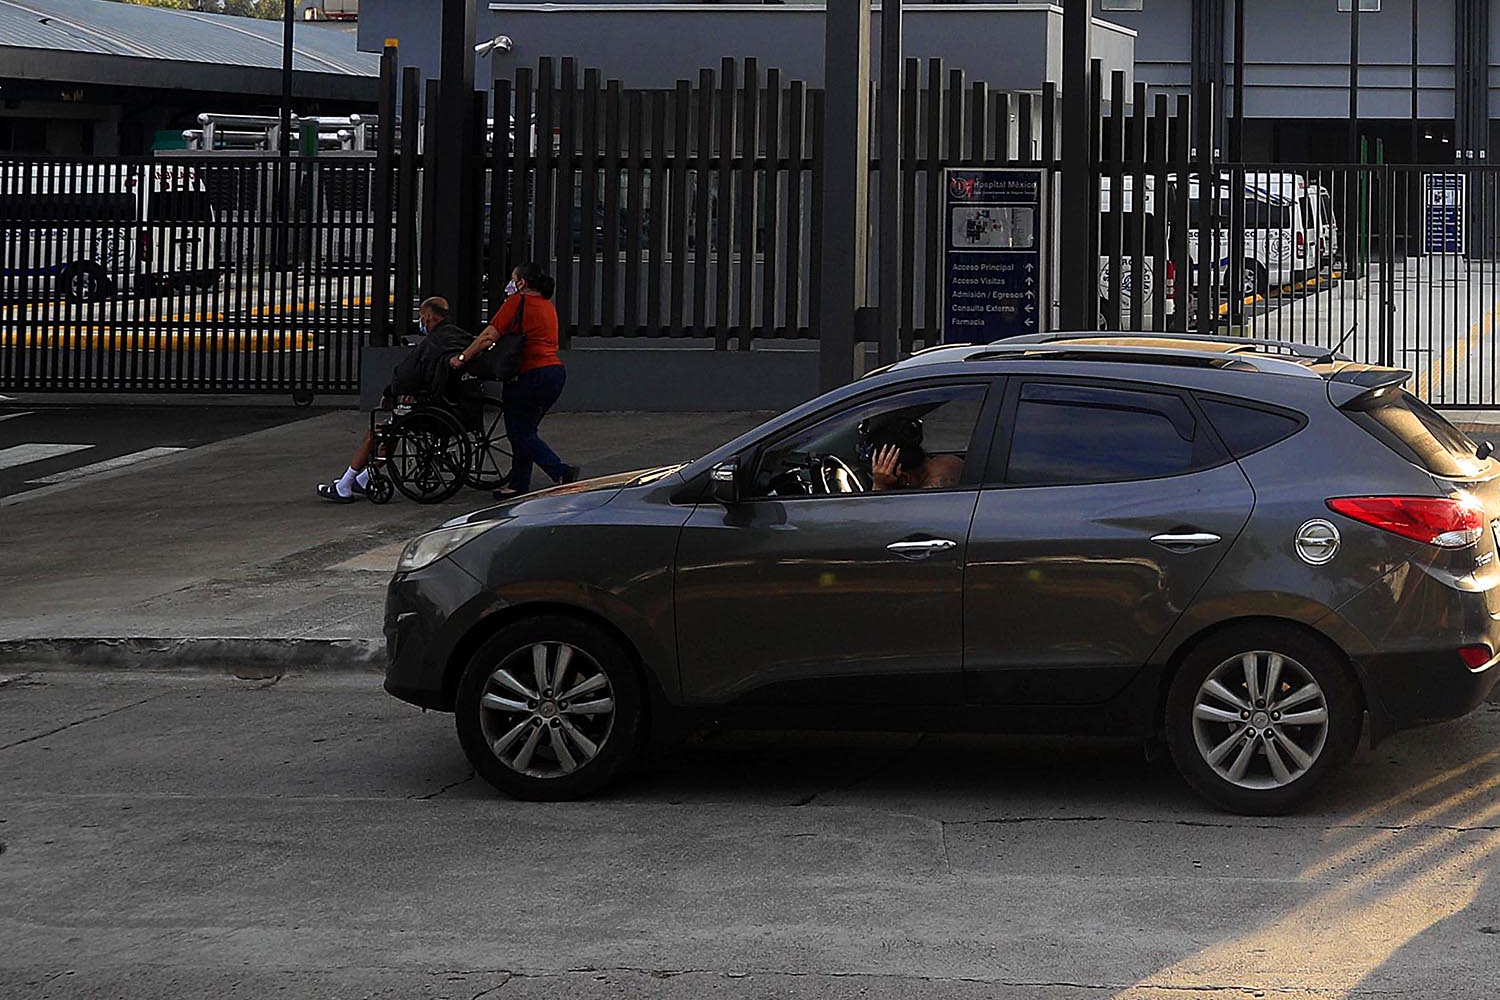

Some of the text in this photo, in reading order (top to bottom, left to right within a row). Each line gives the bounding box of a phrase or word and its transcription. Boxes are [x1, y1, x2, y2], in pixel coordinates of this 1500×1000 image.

[974, 180, 1036, 189] Hospital México
[980, 264, 1014, 272] Principal
[980, 277, 1006, 285] Visitas
[952, 290, 986, 298] Admisión
[992, 291, 1024, 300] Egresos
[951, 304, 984, 312] Consulta
[951, 318, 985, 326] Farmacia
